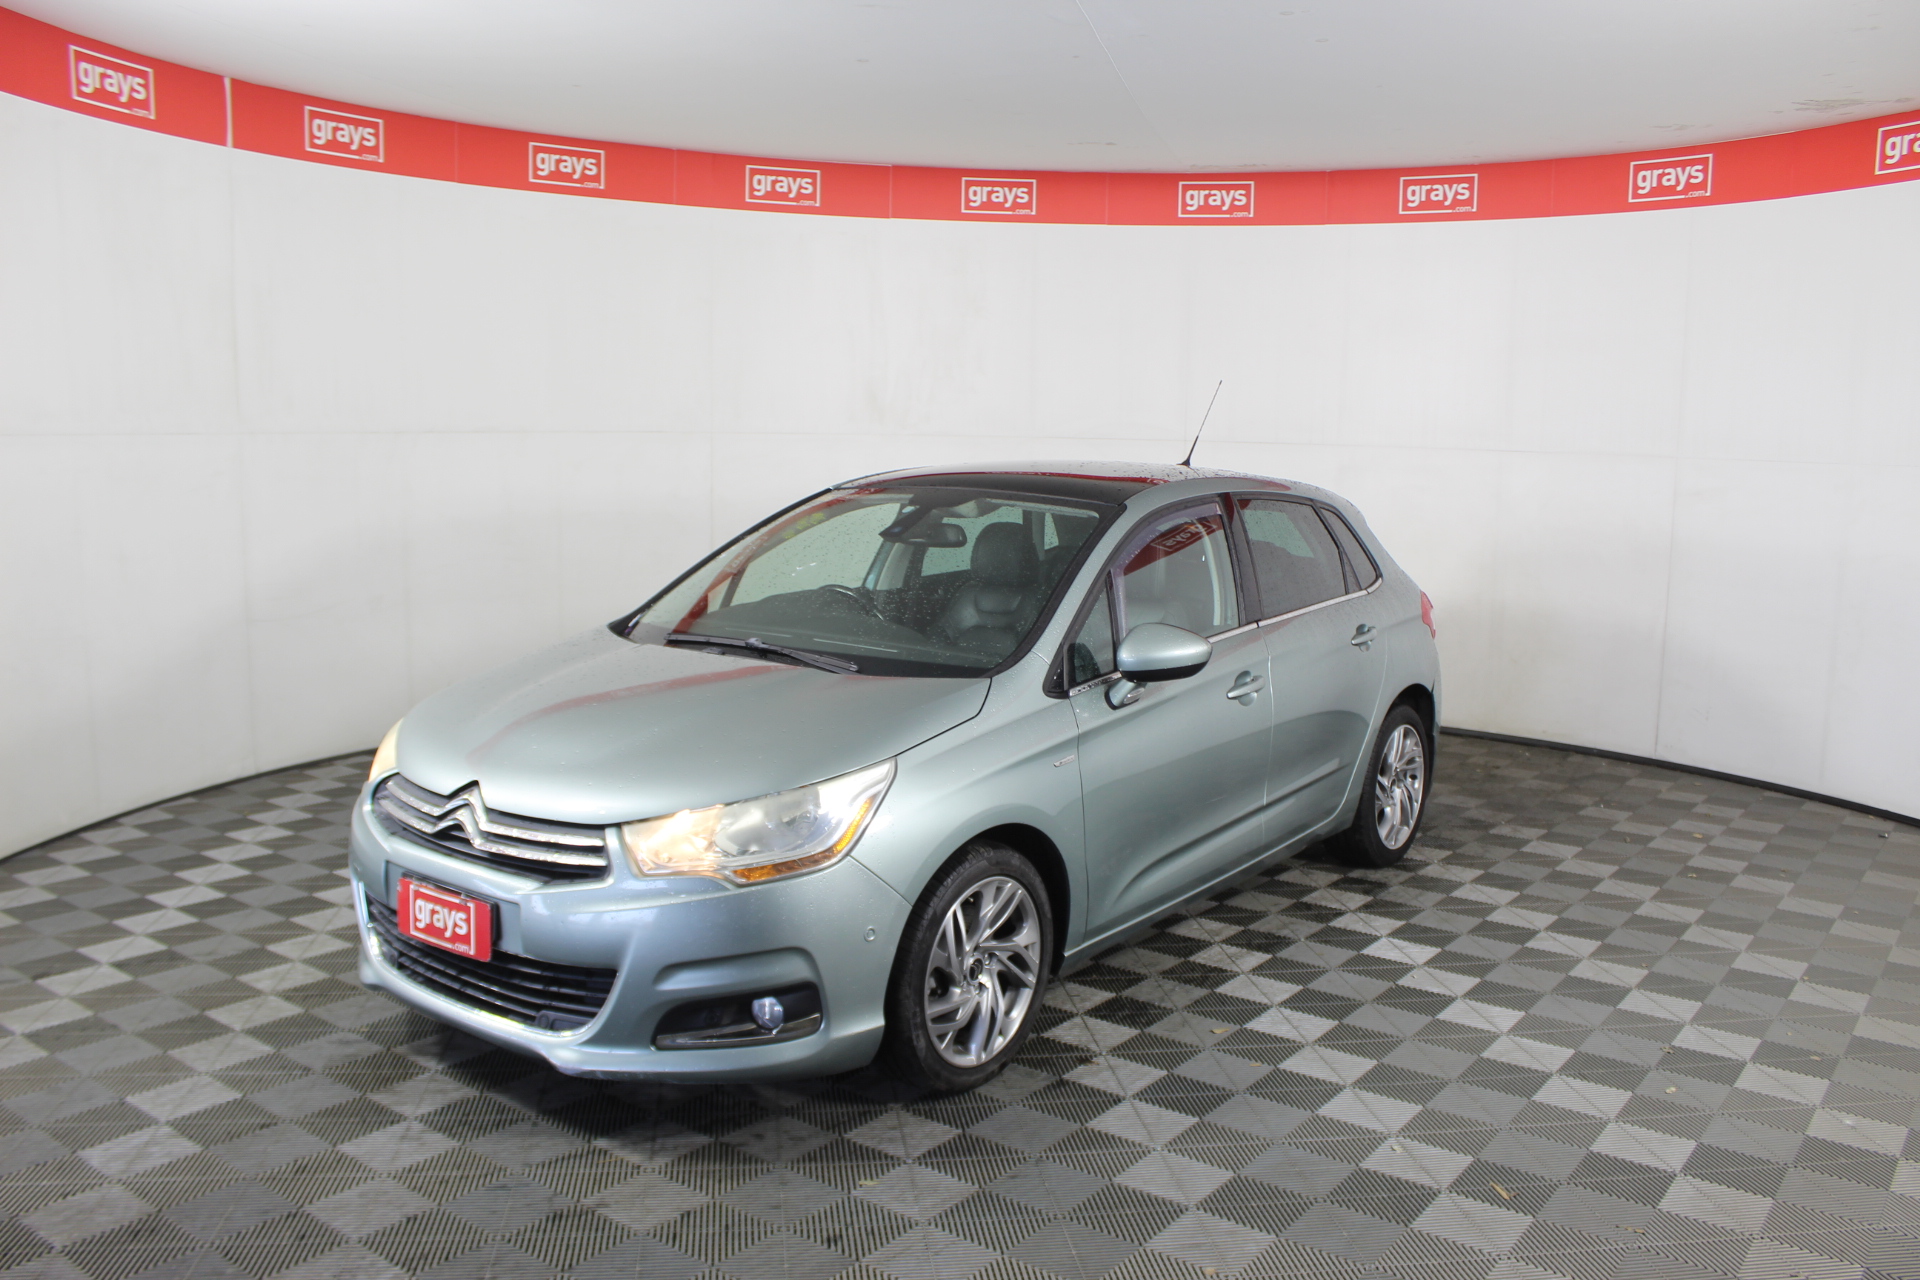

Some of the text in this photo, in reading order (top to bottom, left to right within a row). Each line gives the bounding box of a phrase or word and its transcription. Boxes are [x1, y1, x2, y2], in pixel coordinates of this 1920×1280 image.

[78, 60, 147, 102] grays
[312, 118, 376, 150] grays
[536, 152, 597, 179] grays
[1637, 164, 1704, 194] grays
[753, 174, 813, 198] grays
[968, 185, 1029, 207] grays
[1407, 183, 1470, 206] grays
[1185, 189, 1247, 212] grays
[415, 899, 468, 938] grays
